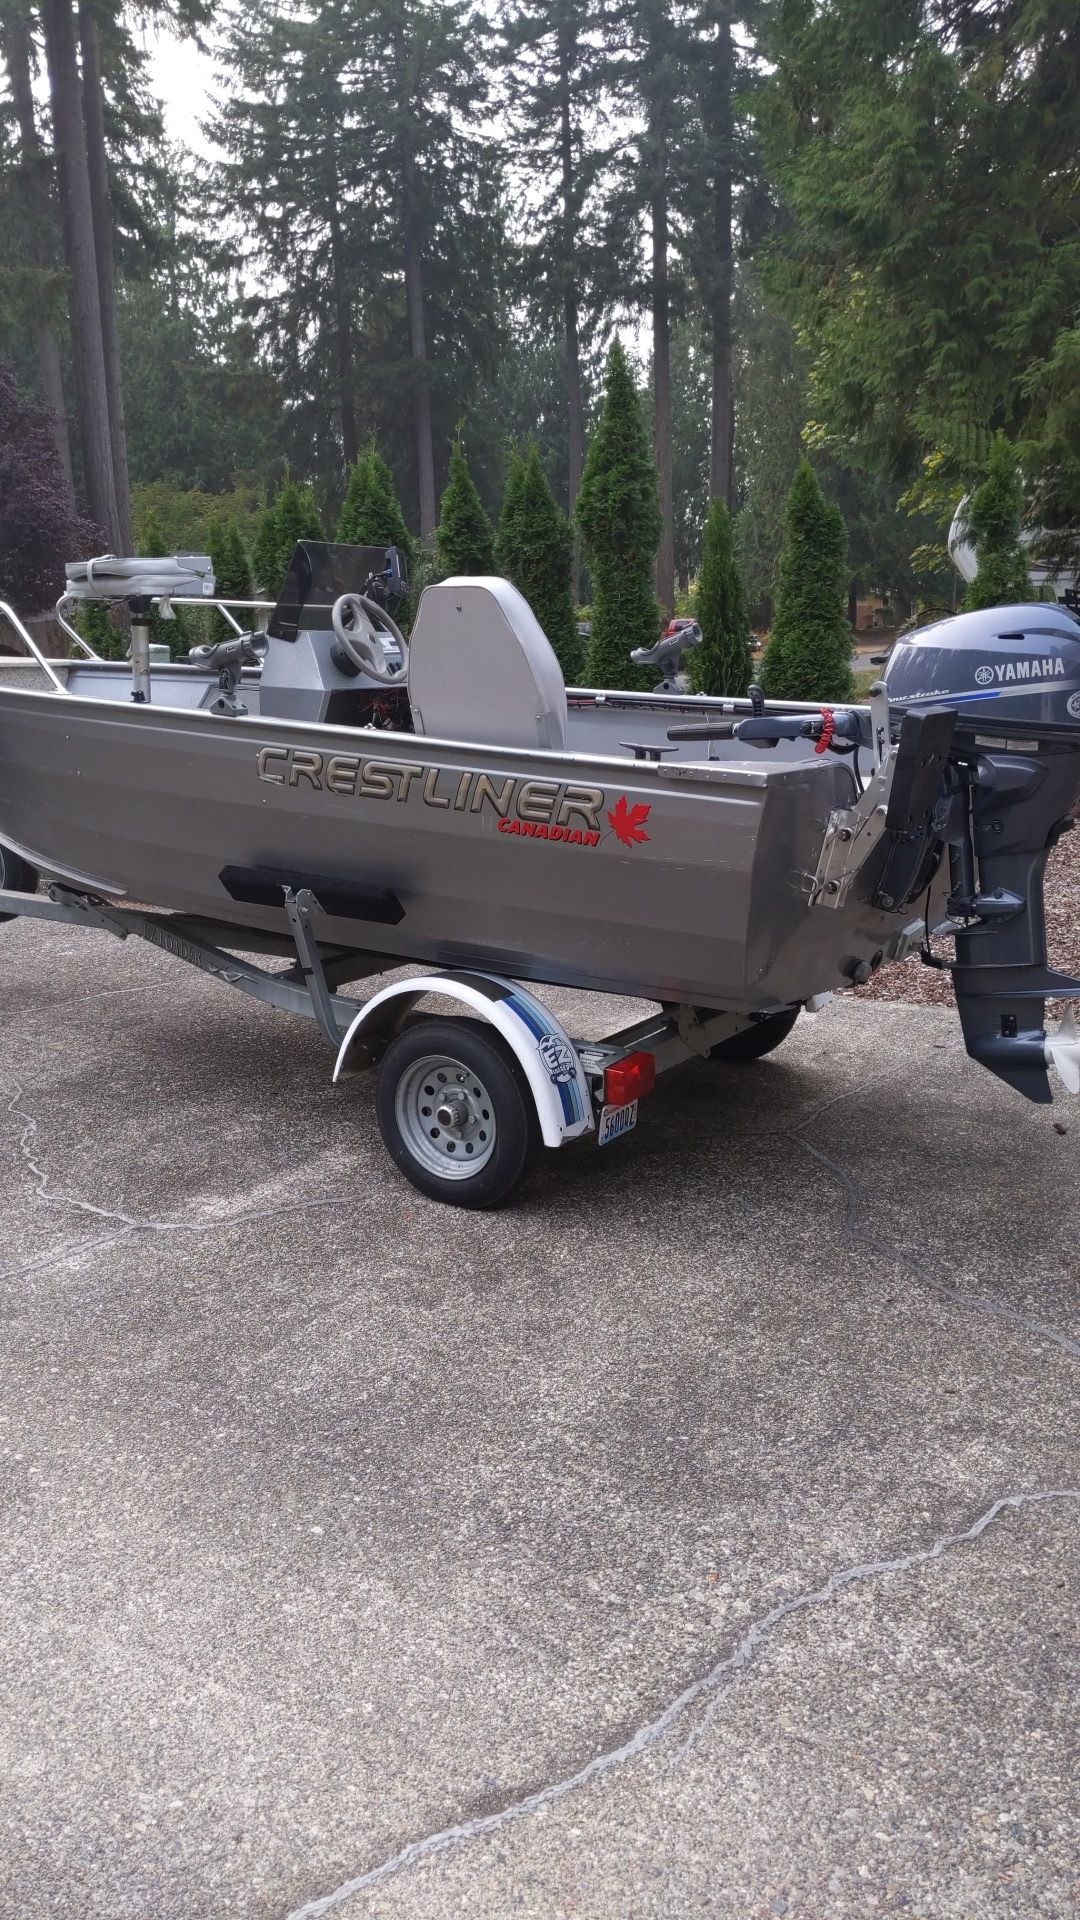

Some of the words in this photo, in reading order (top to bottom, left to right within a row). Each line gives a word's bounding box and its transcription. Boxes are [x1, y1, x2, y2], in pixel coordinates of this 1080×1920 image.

[995, 657, 1065, 681] YAMAHA
[888, 689, 950, 703] ourstroke
[256, 746, 606, 830] CRESTLINER
[496, 817, 601, 847] CANADIAN
[543, 1045, 572, 1070] EZ
